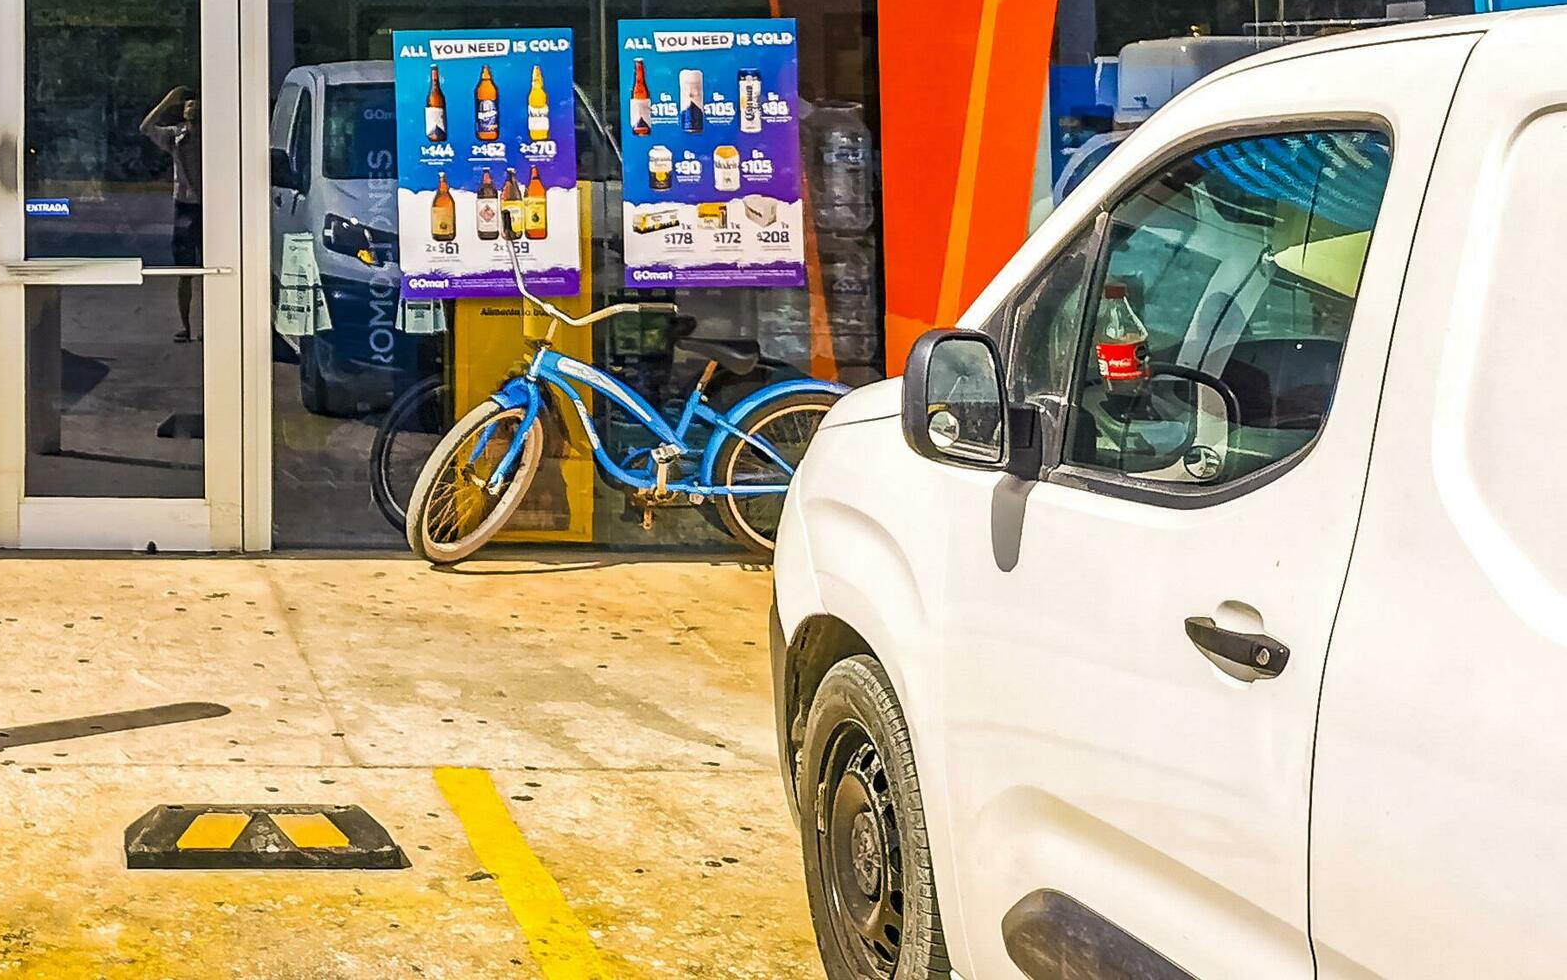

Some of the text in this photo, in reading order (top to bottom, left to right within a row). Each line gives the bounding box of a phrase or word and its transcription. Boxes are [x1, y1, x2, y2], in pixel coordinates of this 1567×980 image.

[624, 32, 793, 49] ALL YOU NEED IS COLD
[400, 39, 569, 58] ALL YOU NEED IS COLD
[364, 109, 395, 120] GOm
[26, 203, 69, 213] ENTRADA
[633, 271, 673, 281] GOmart
[409, 279, 449, 290] GOmart
